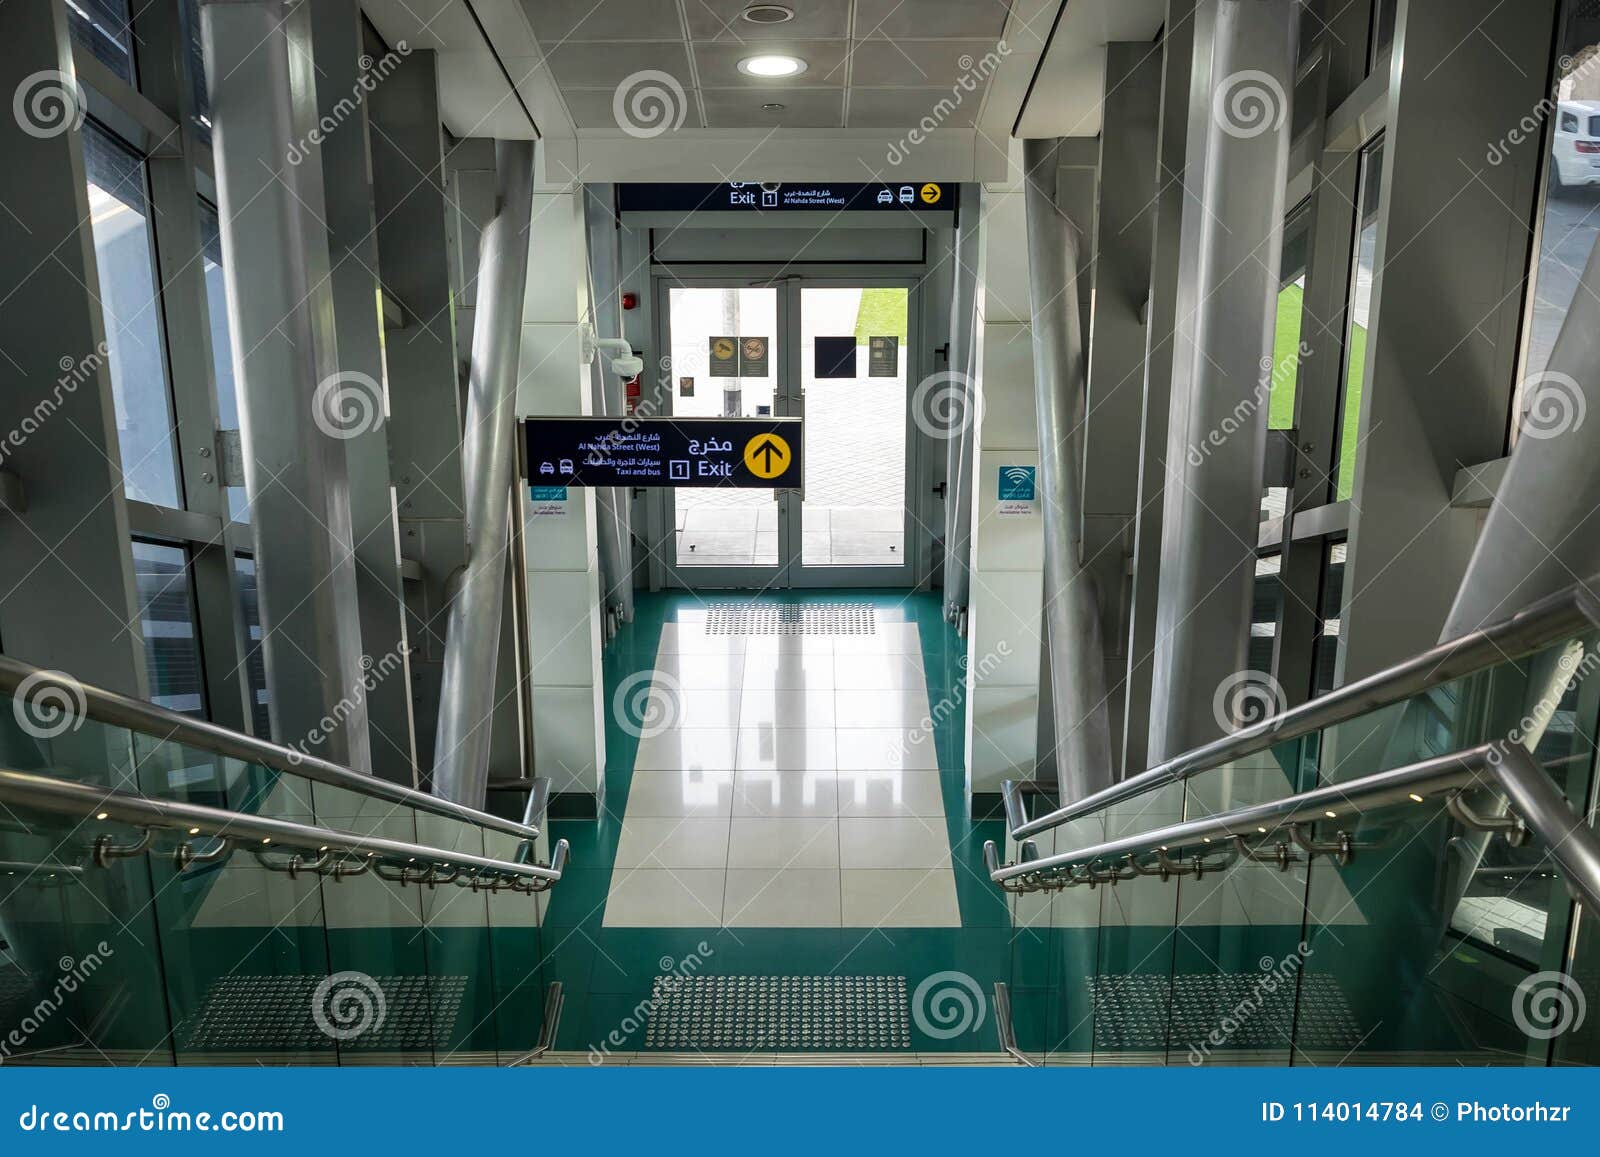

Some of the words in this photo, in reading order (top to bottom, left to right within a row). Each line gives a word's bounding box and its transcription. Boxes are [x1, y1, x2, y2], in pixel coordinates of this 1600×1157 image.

[730, 191, 756, 204] Exit
[642, 433, 660, 443] شارع
[578, 443, 587, 451] Al
[588, 443, 611, 451] Nahda
[612, 443, 635, 451] Street
[635, 443, 660, 452] (West)
[688, 437, 733, 456] مخرج
[616, 467, 632, 475] Taxi
[632, 467, 647, 475] and
[647, 467, 660, 475] bus
[698, 460, 732, 476] Exit
